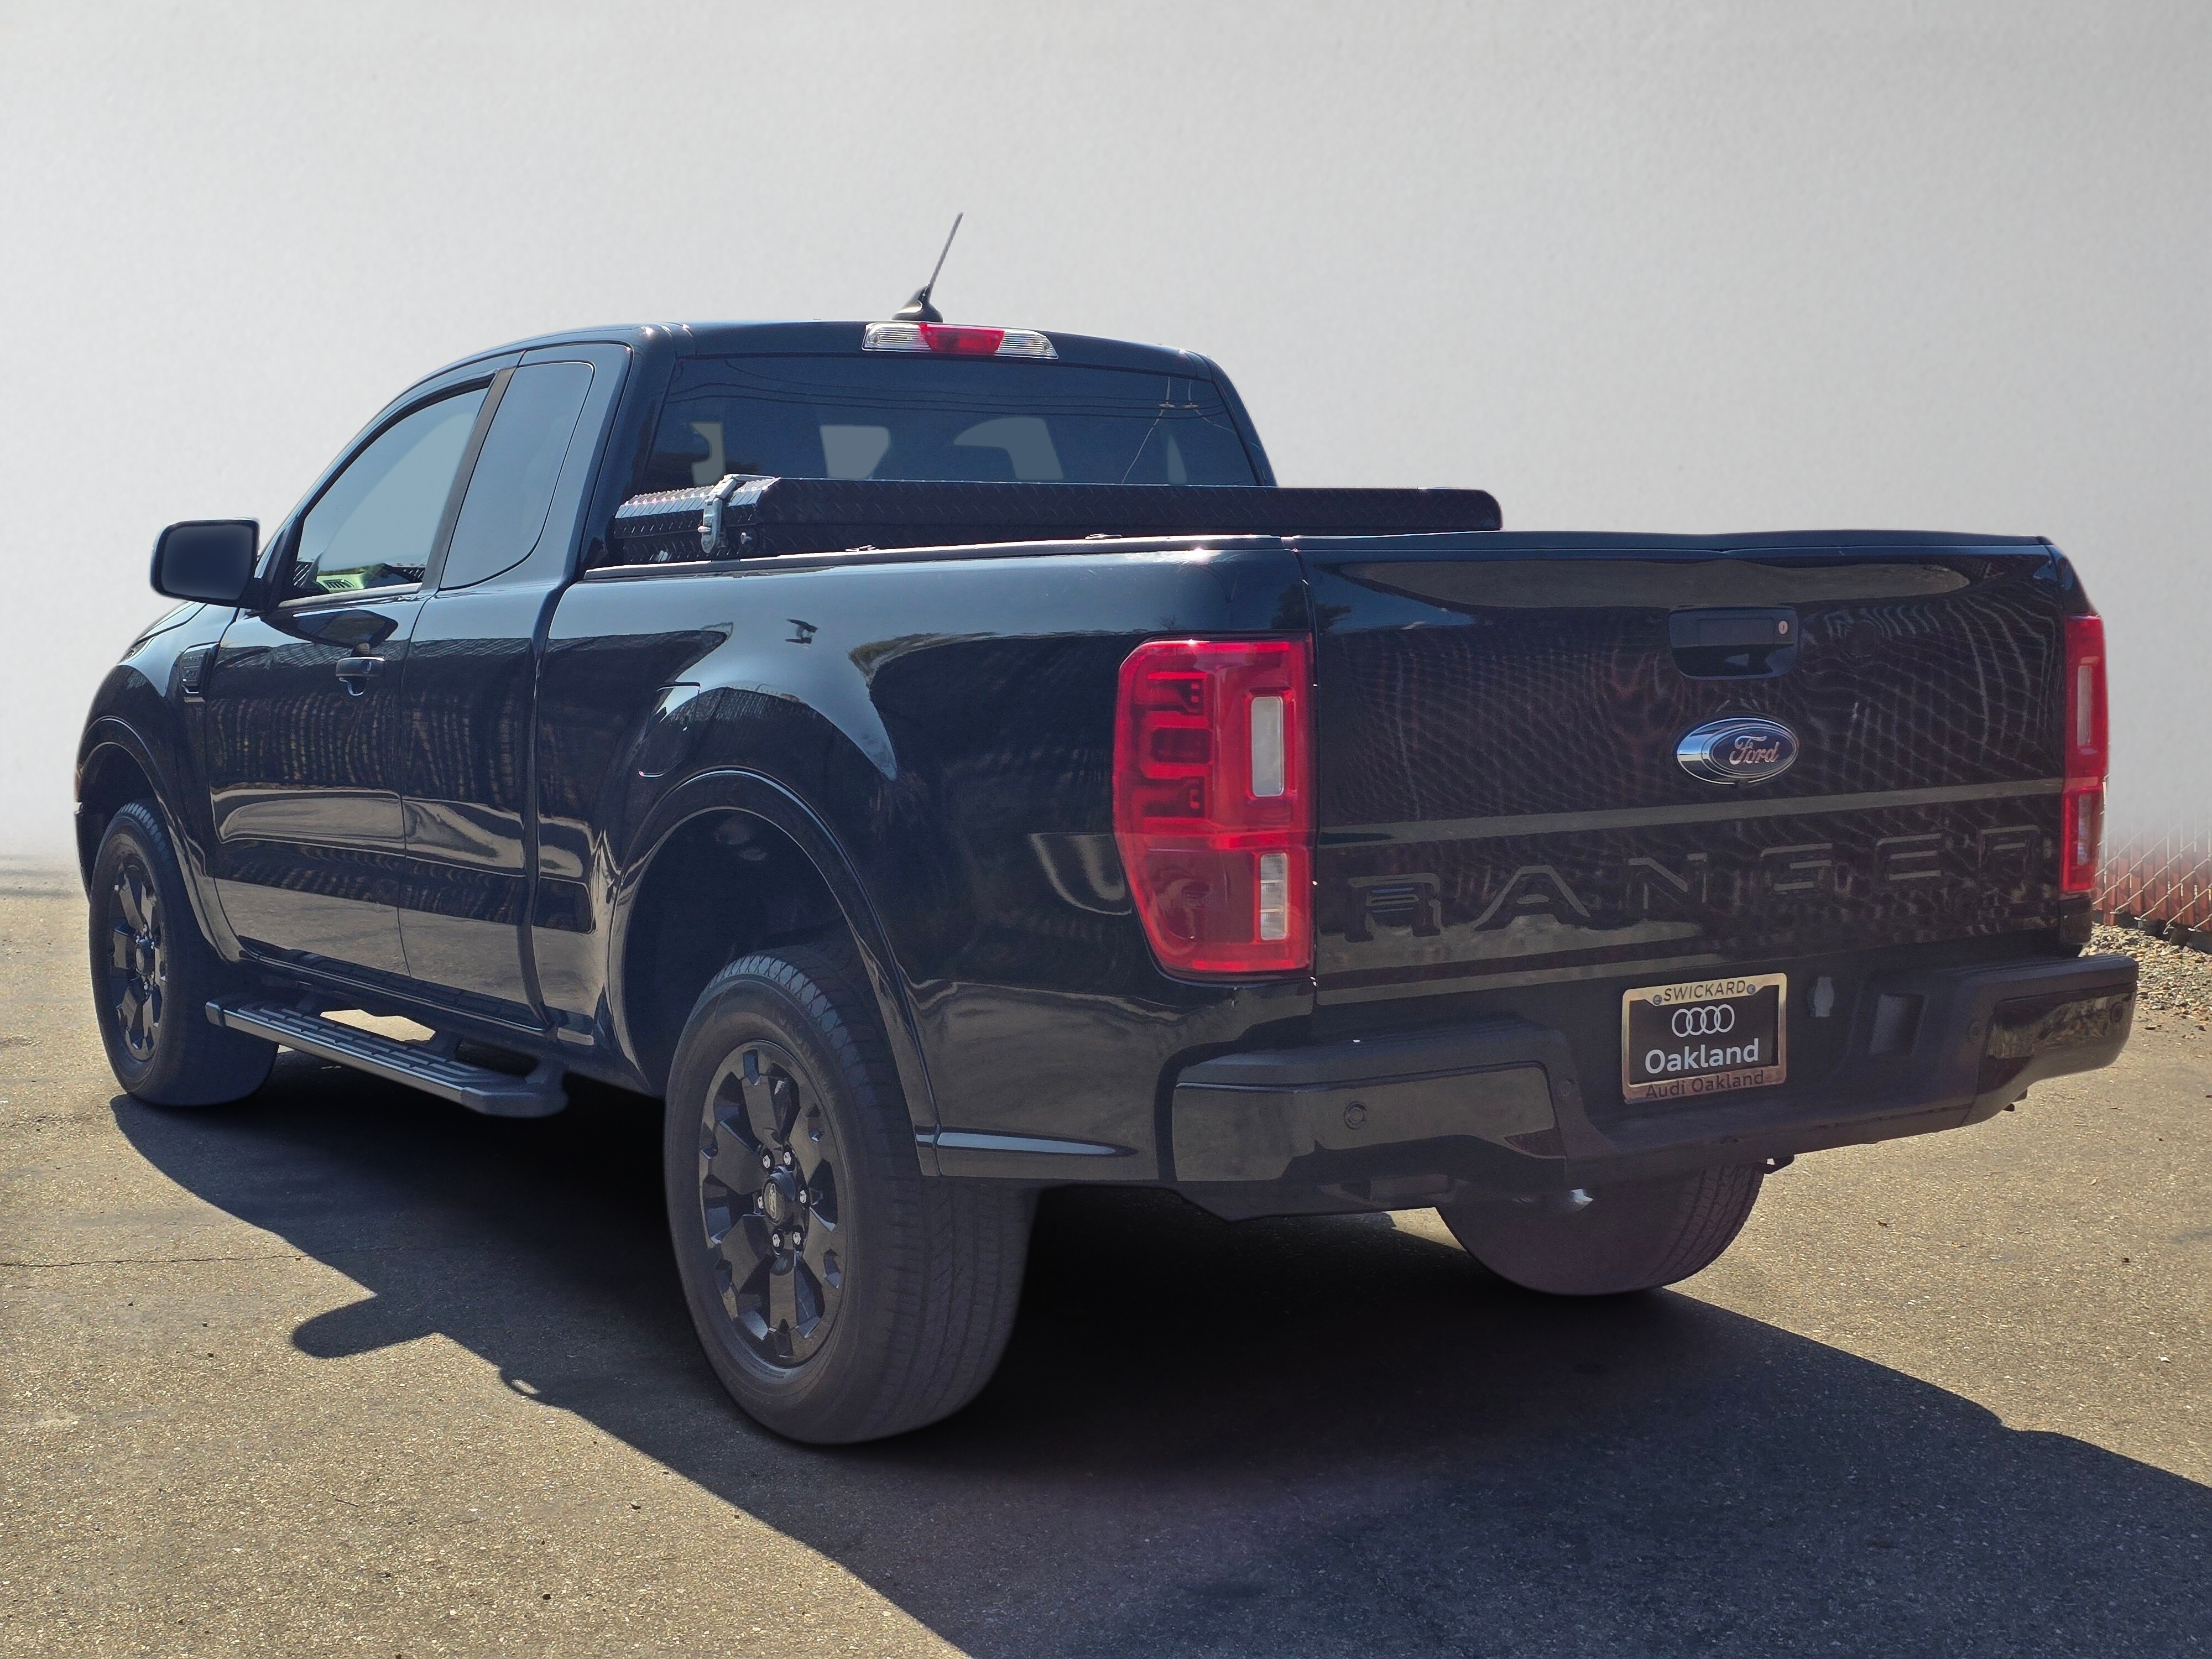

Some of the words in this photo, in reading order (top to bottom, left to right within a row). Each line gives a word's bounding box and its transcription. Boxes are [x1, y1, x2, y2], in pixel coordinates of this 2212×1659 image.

[1729, 735, 1780, 765] Ford
[1345, 825, 2043, 943] RANGER
[1663, 980, 1746, 1002] SWICKARD
[1645, 1037, 1759, 1074] Oakland
[1644, 1079, 1686, 1100] Audi
[1691, 1070, 1764, 1093] Oakland
